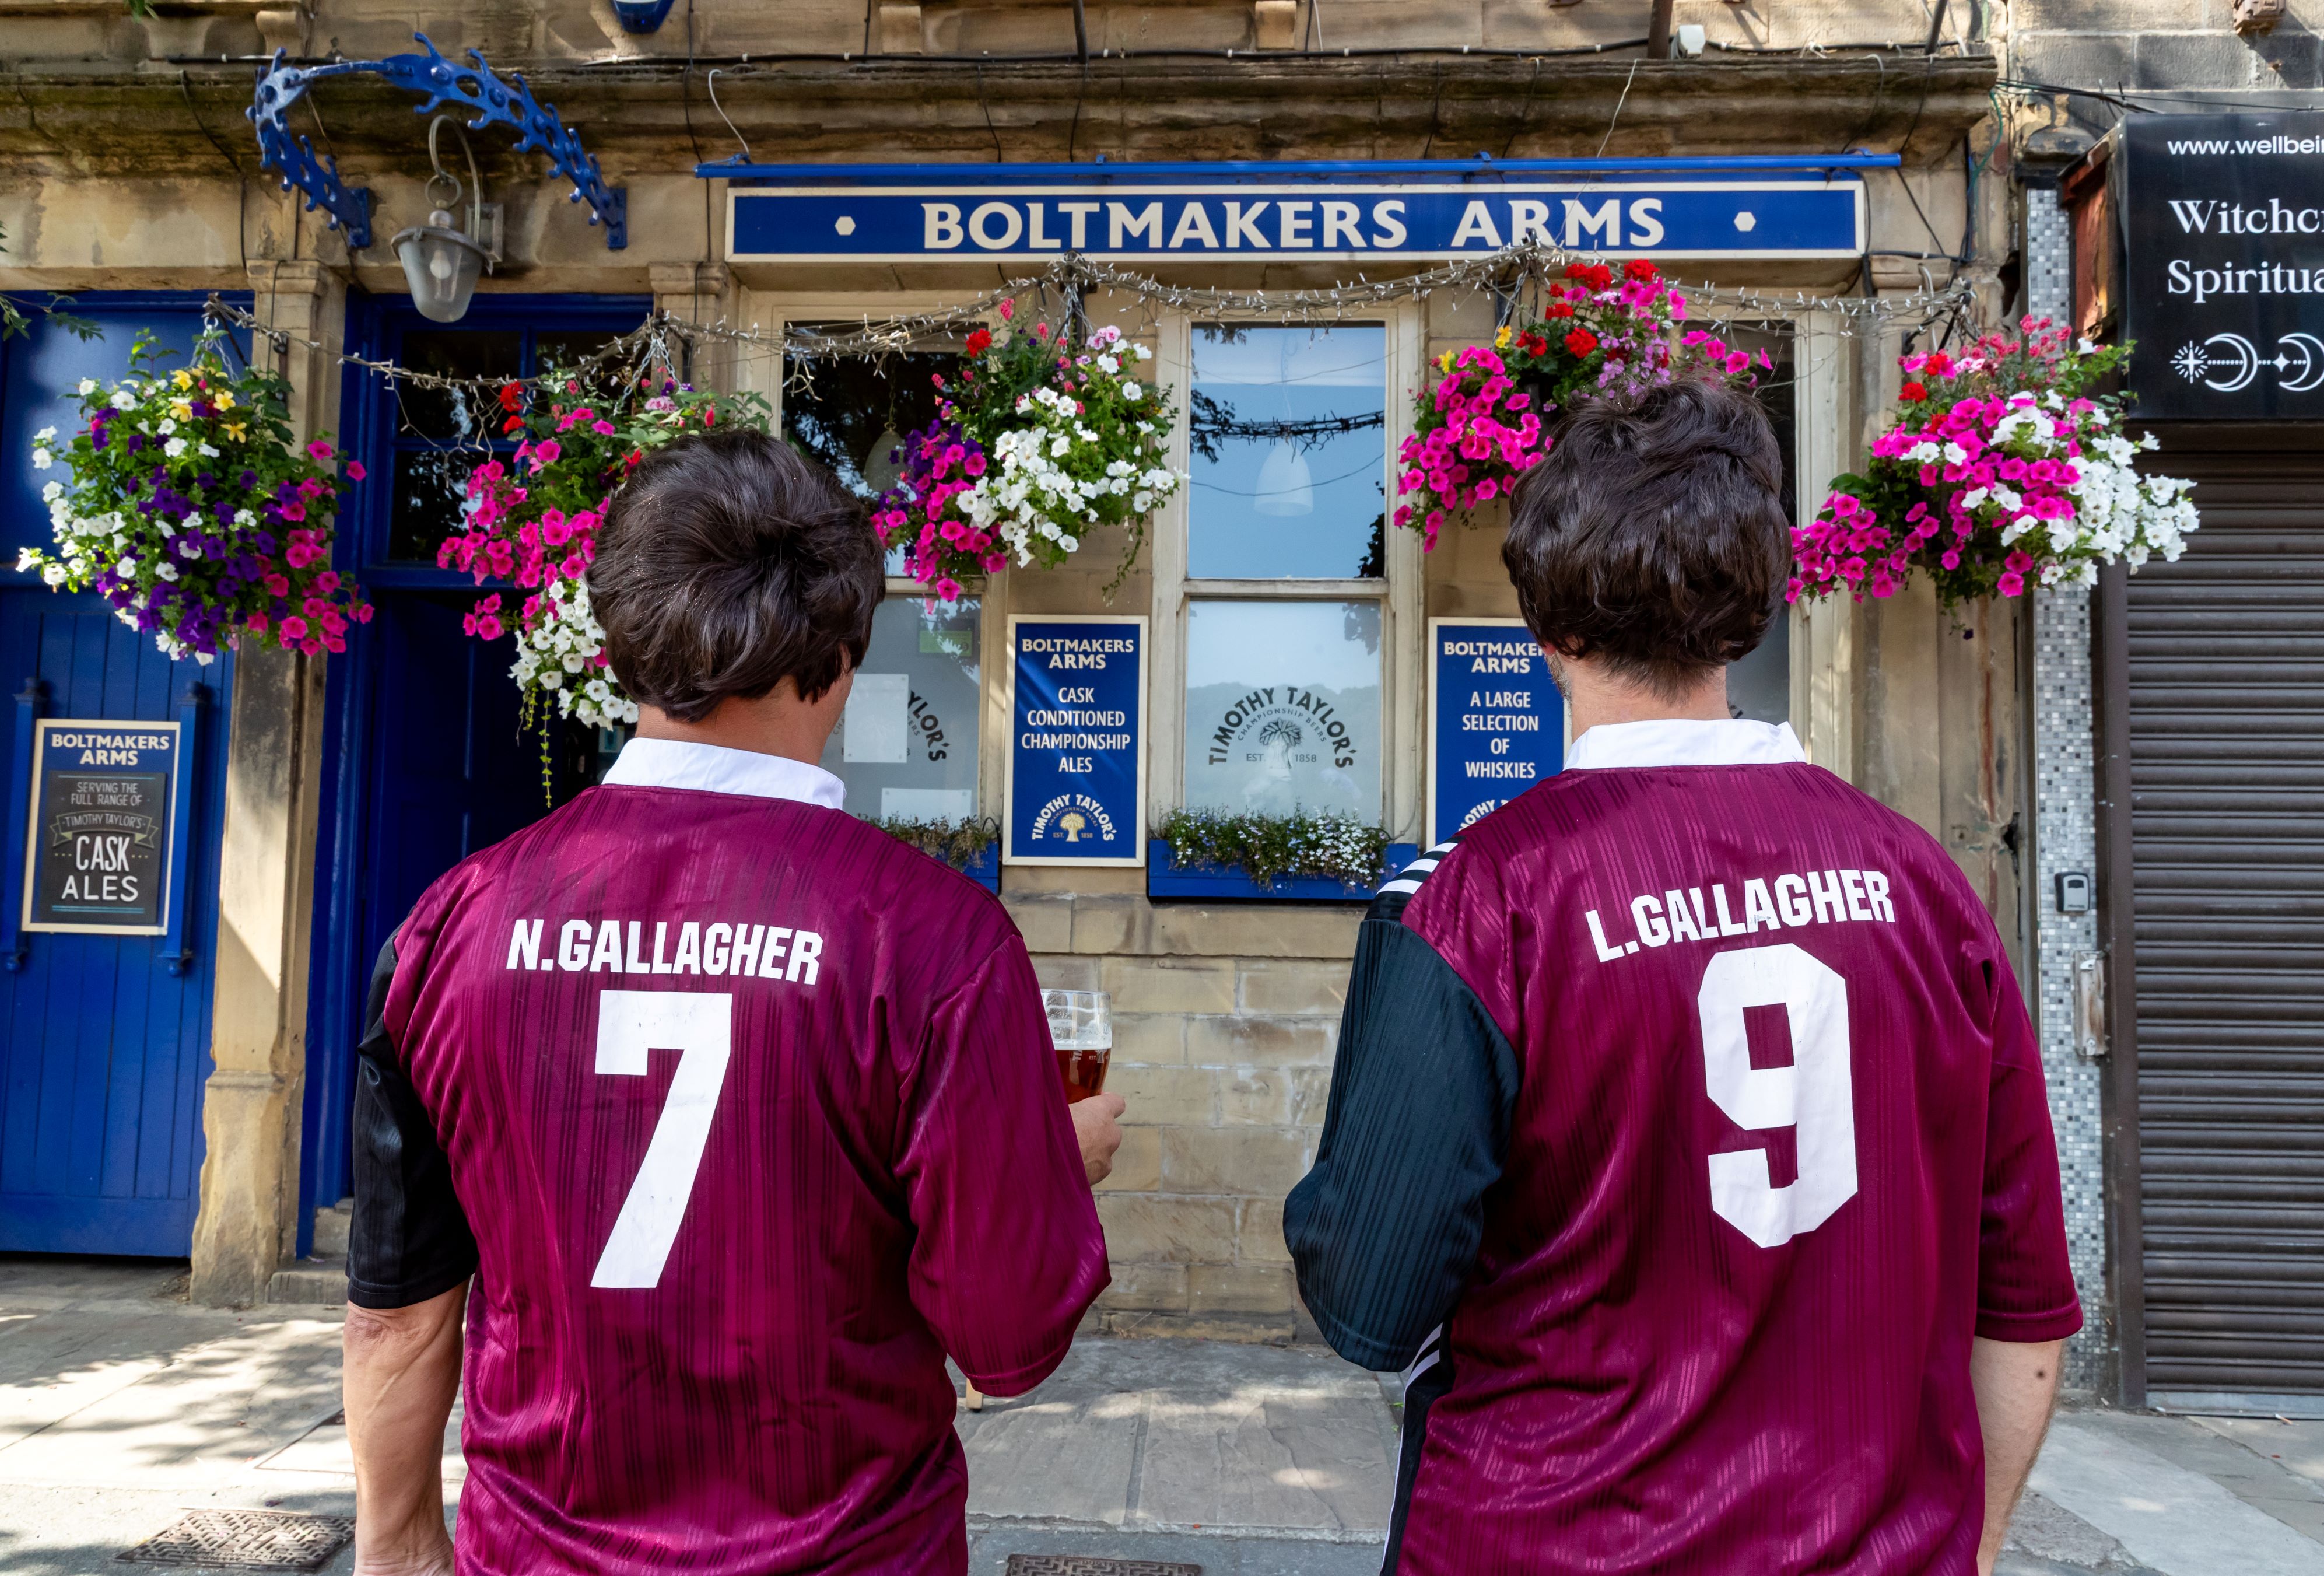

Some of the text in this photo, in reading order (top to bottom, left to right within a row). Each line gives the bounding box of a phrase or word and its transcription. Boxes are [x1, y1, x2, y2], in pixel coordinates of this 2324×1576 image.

[2167, 135, 2324, 154] www.wellbei
[921, 198, 1664, 250] BOLTMAKERS ARMS
[2168, 198, 2324, 234] Witchc
[1022, 639, 1134, 653] BOLTMAKERS
[1444, 642, 1543, 657] BOLTMAKE
[1049, 654, 1106, 670] ARMS
[1471, 657, 1530, 673] ARMS
[1058, 687, 1095, 703] CASK
[1470, 692, 1531, 708] A LARGE
[907, 689, 950, 762] YLOR'S
[1027, 710, 1125, 726] CONDITIONED
[1238, 708, 1327, 742] CHAMPIONSHIP BEERS
[1462, 715, 1538, 731] SELECTION
[1208, 686, 1357, 768] TIMOTHY TAYLOR'S
[51, 734, 169, 750] BOLTMAKERS
[1021, 733, 1131, 750] CHAMPIONSHIP
[1490, 738, 1510, 754] OF
[80, 750, 138, 766] ARMS
[1058, 757, 1092, 773] ALES
[1294, 754, 1317, 762] 1858
[1465, 762, 1536, 779] WHISKIES
[77, 782, 139, 794] SERVING THE
[71, 793, 142, 806] FULL RANGE OF
[65, 814, 142, 829] TIMOTHY TAYLOR'S
[1032, 794, 1117, 841] TIMOTHY TAYLOR'S
[1049, 807, 1085, 826] CHAMPIONSHIP
[76, 835, 130, 871] CASK
[61, 875, 139, 902] ALES
[1585, 869, 1895, 962] L.GALLAGHER
[506, 919, 823, 985] N.GALLAGHER
[1697, 943, 1858, 1248] 9
[590, 989, 732, 1288] 7
